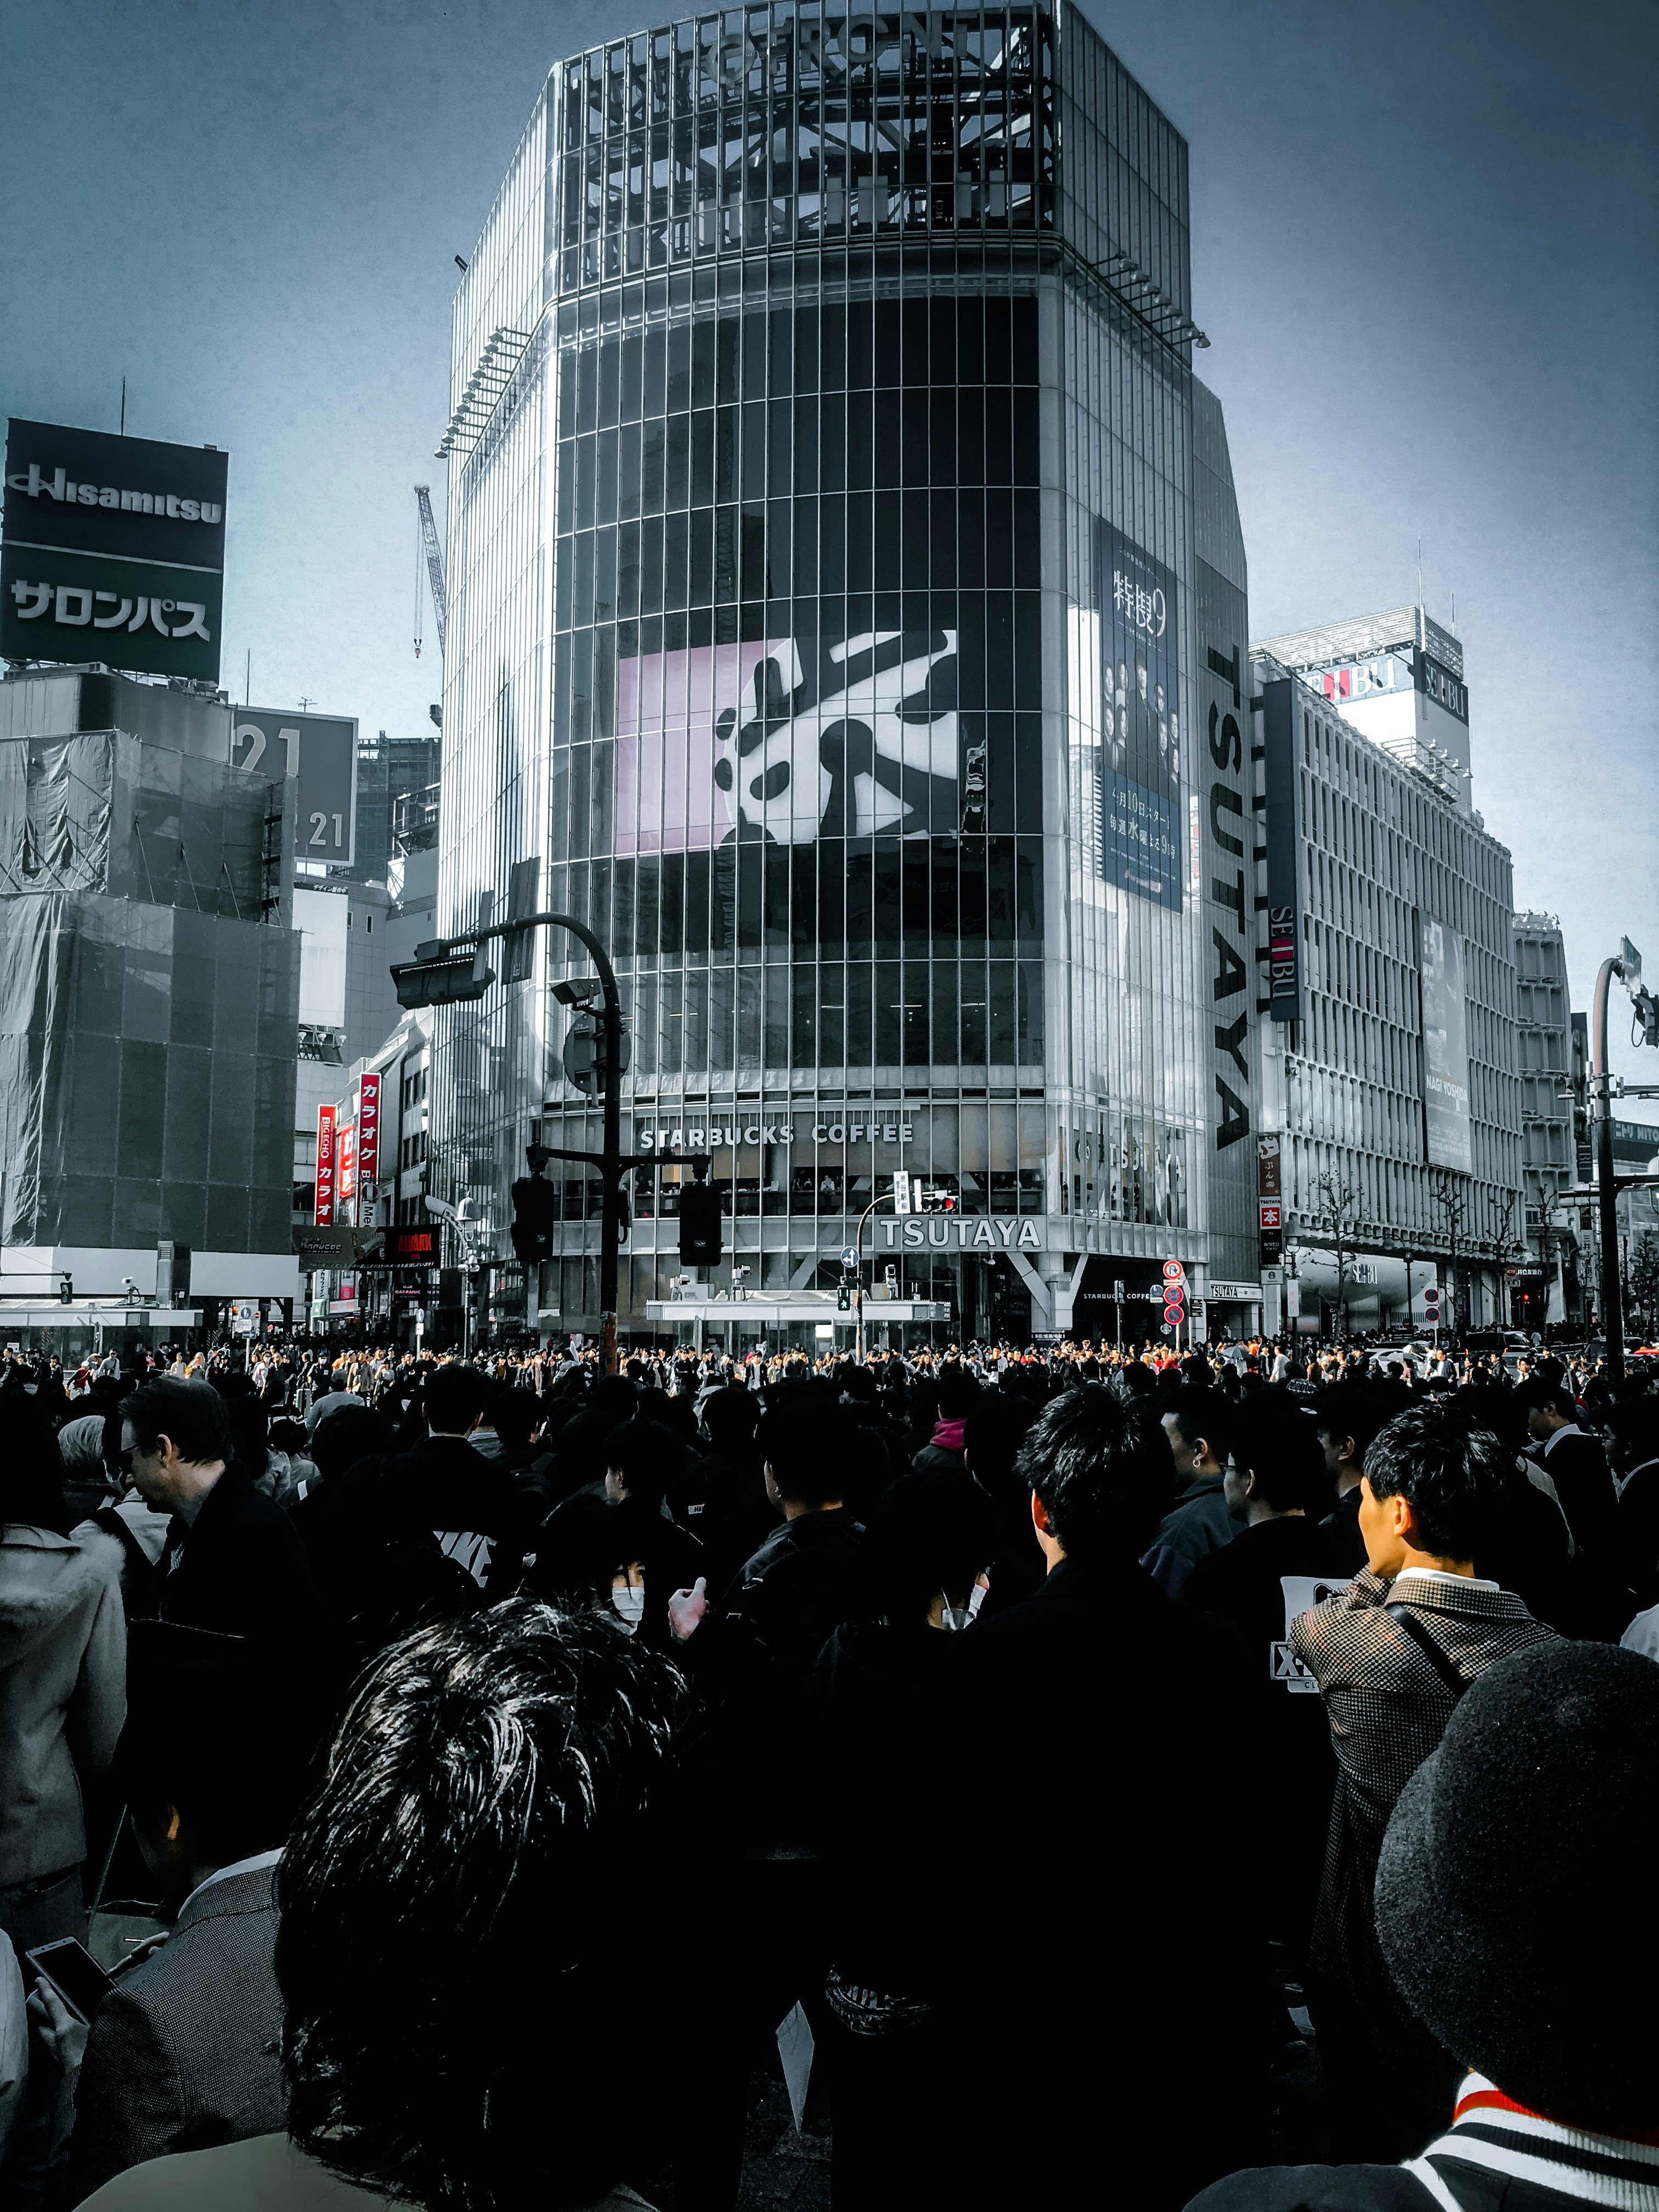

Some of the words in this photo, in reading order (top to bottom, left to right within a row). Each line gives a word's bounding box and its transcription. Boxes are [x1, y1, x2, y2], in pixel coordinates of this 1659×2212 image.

[7, 464, 222, 523] Hisamitsu
[11, 579, 211, 642] サロンパス
[309, 812, 342, 847] 21
[1208, 644, 1250, 1152] TSUTAYA
[1271, 906, 1296, 1000] SEIBU
[1426, 1074, 1442, 1093] NAGI
[1443, 1080, 1468, 1103] YOSHIDA
[360, 1084, 377, 1161] カラオケ
[640, 1125, 794, 1149] STARBUCKS
[812, 1124, 913, 1144] COFFEE
[1616, 1123, 1634, 1139] ニトリ
[363, 1206, 374, 1227] Me
[1263, 1209, 1278, 1224] 本
[879, 1219, 1041, 1247] TSUTAYA
[1352, 1263, 1378, 1284] SEIBU
[1211, 1285, 1238, 1298] TSUTAYA
